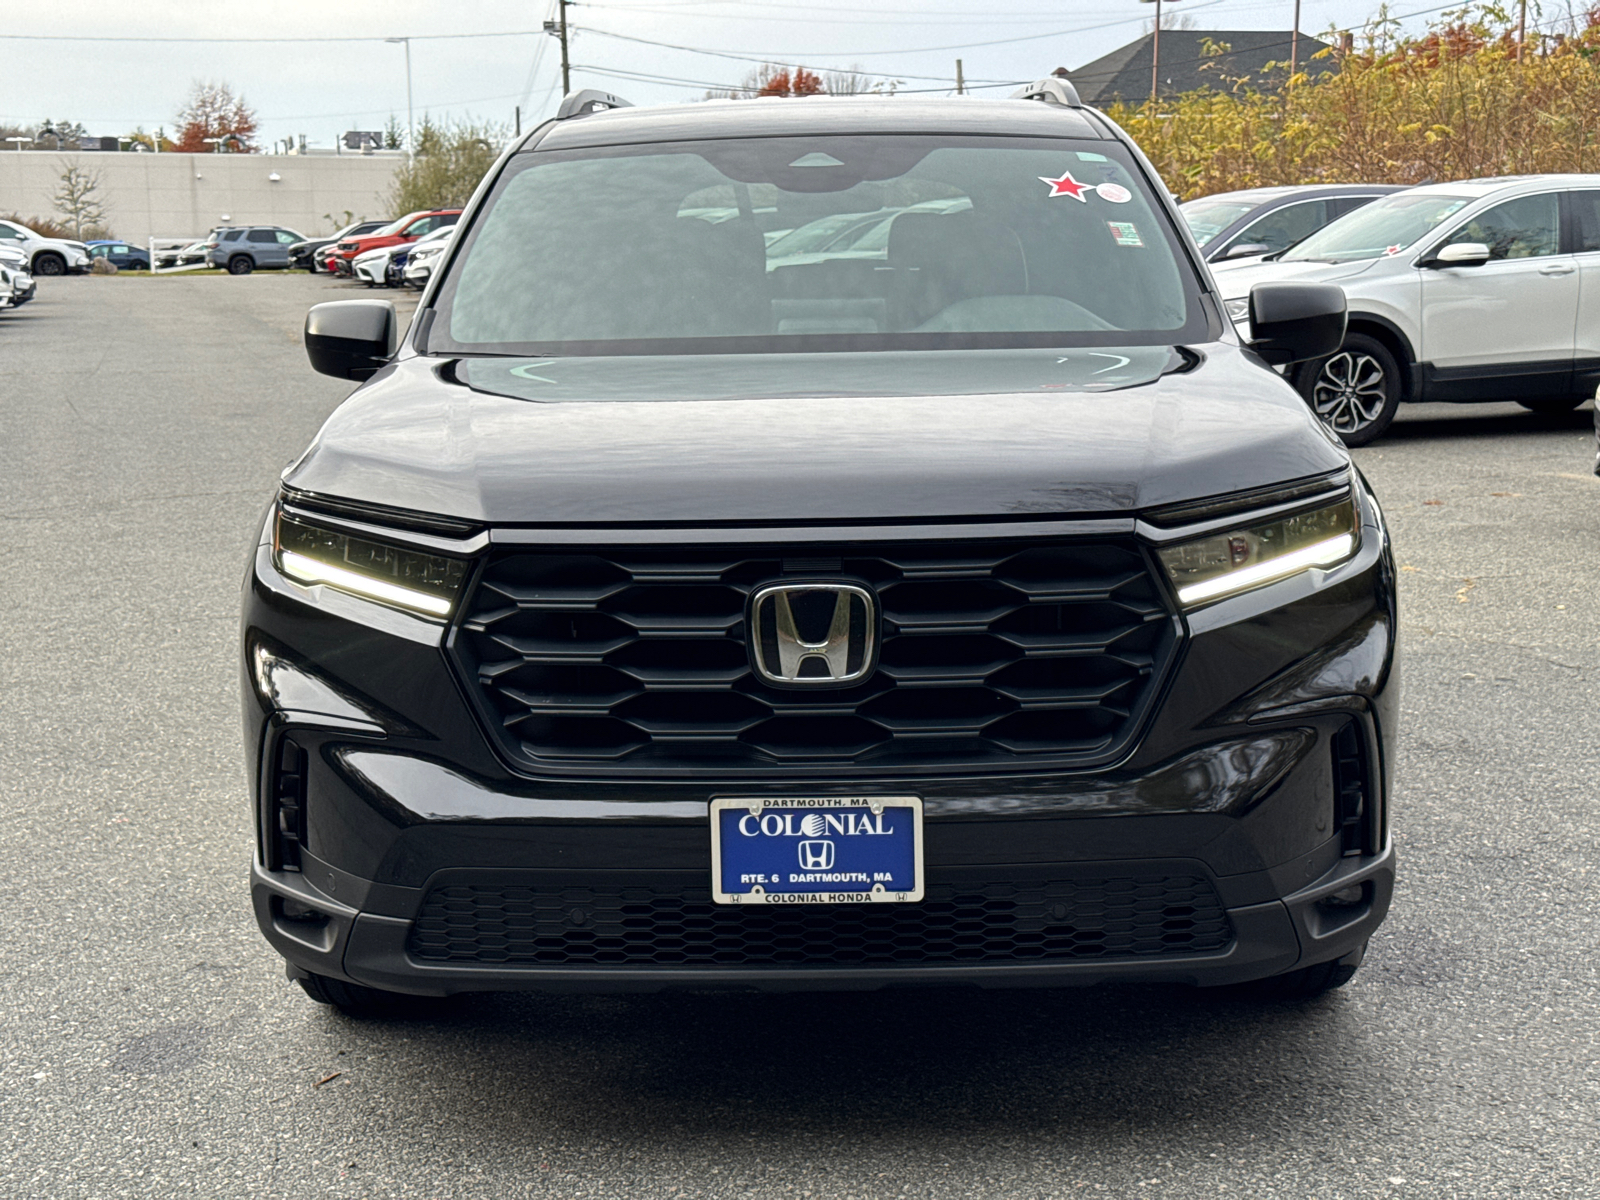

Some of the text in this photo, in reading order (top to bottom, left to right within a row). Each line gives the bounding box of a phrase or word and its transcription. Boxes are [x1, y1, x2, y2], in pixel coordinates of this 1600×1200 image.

[738, 813, 894, 837] COLONIAL
[741, 872, 893, 883] RTE. 6 DARTMOUTH, MA
[765, 893, 872, 903] COLONIAL HONDA
